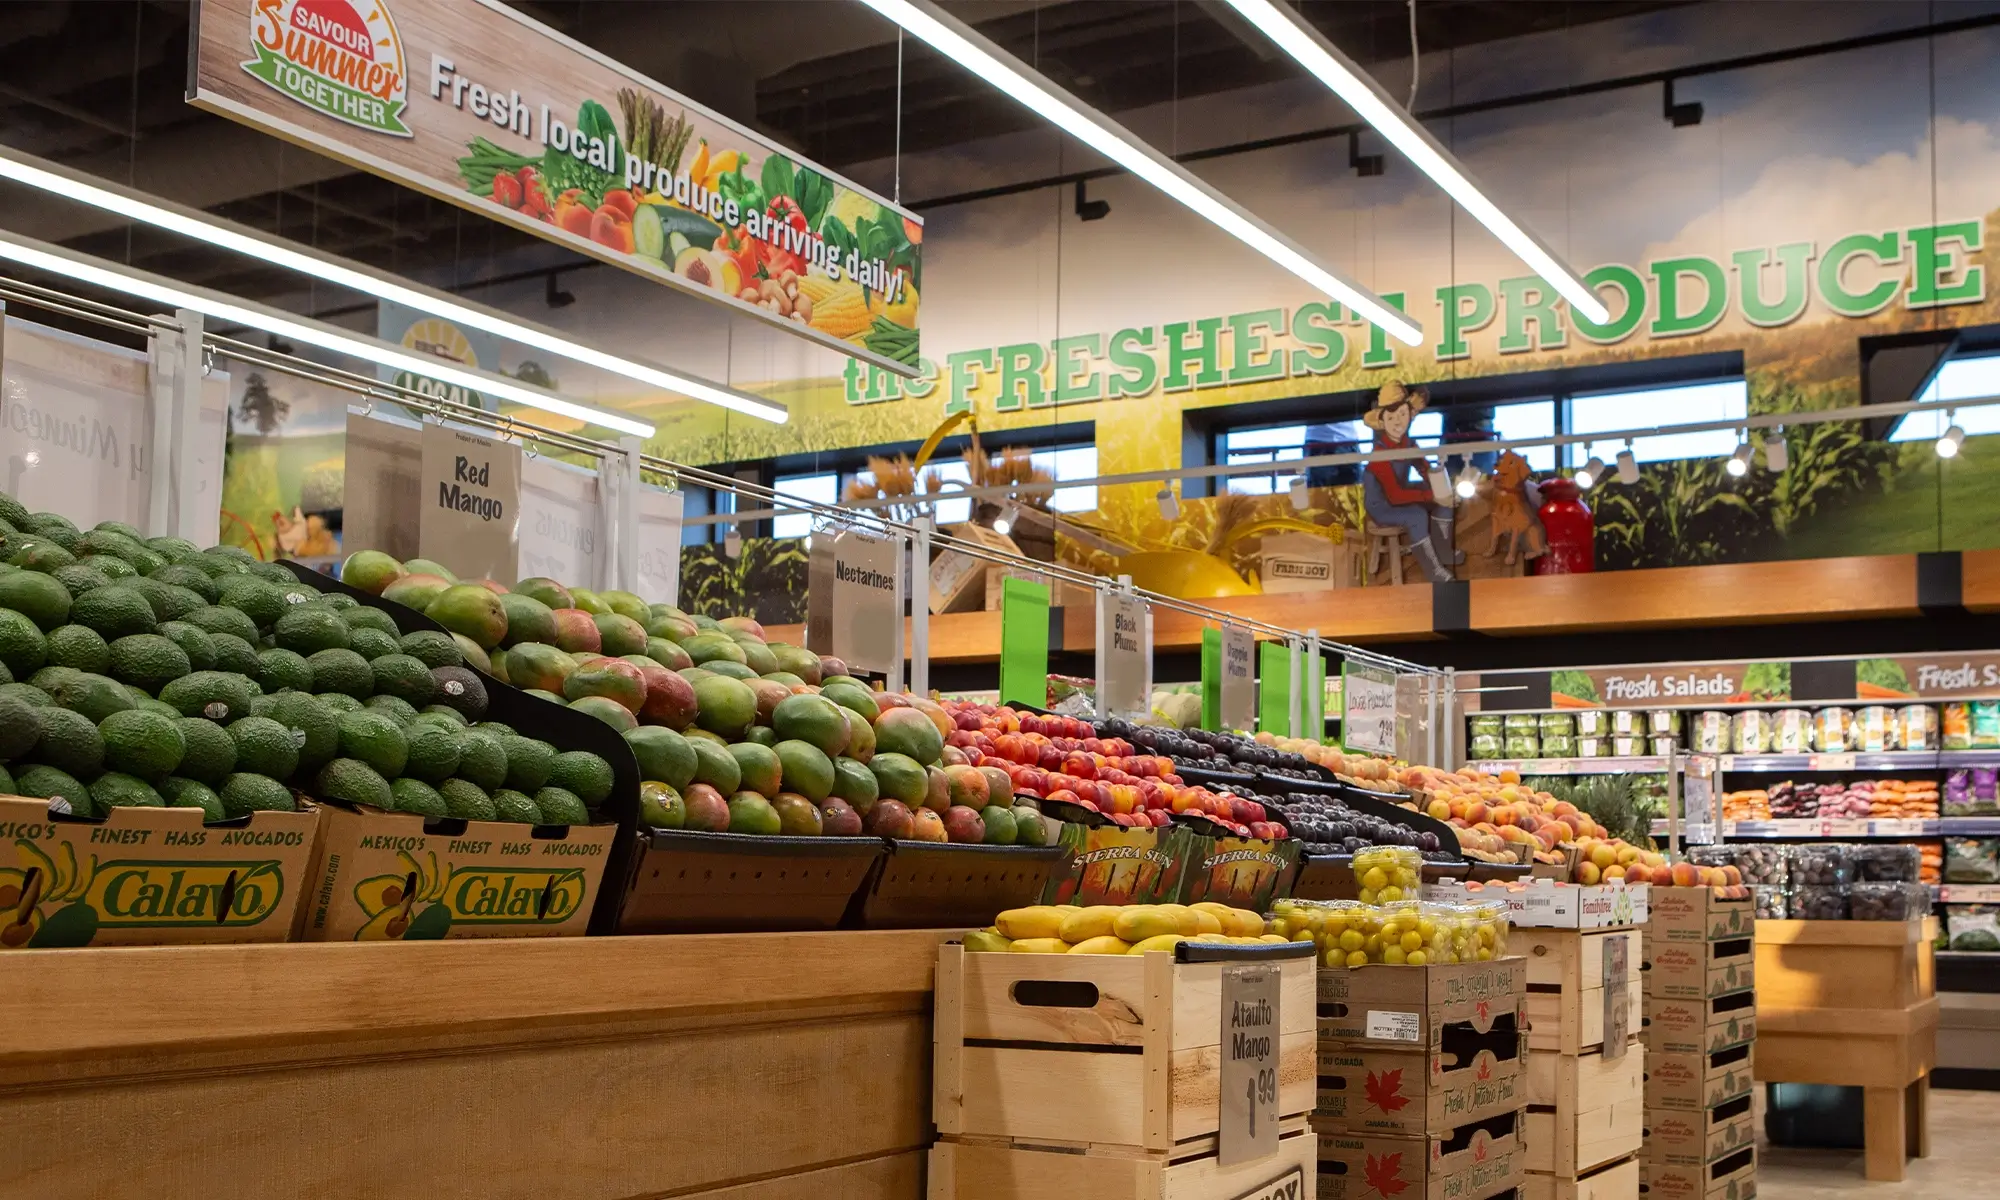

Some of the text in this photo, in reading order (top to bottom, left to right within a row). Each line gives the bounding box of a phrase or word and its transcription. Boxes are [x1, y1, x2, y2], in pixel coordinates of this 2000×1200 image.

[295, 7, 370, 56] SAVOUR
[258, 0, 403, 104] Summer
[273, 57, 386, 125] TOGETHER
[430, 53, 904, 303] Fresh local produce arriving daily!
[843, 218, 1986, 414] the FRESHEST PRODUCE
[455, 455, 489, 487] Red
[439, 481, 503, 522] Mango
[836, 559, 893, 591] Nectarines
[1115, 613, 1136, 633] Black
[1114, 632, 1137, 652] Plums
[1605, 673, 1734, 700] Fresh Salads
[1917, 662, 1981, 691] Fresh
[90, 828, 152, 845] FINEST
[164, 830, 208, 846] HASS
[221, 830, 304, 847] AVOCADOS
[360, 834, 604, 856] MEXICO'S FINEST HASS AVOCADOS
[1071, 846, 1174, 870] SIERRA SUN
[1202, 849, 1290, 871] SIERRA SUN
[314, 854, 341, 929] www.calavo.com
[1232, 999, 1271, 1028] Ataulfo
[1232, 1032, 1270, 1062] Mango
[1331, 1028, 1365, 1038] PRODUCT
[1334, 1057, 1364, 1067] CANADA
[1335, 1140, 1364, 1149] CANADA
